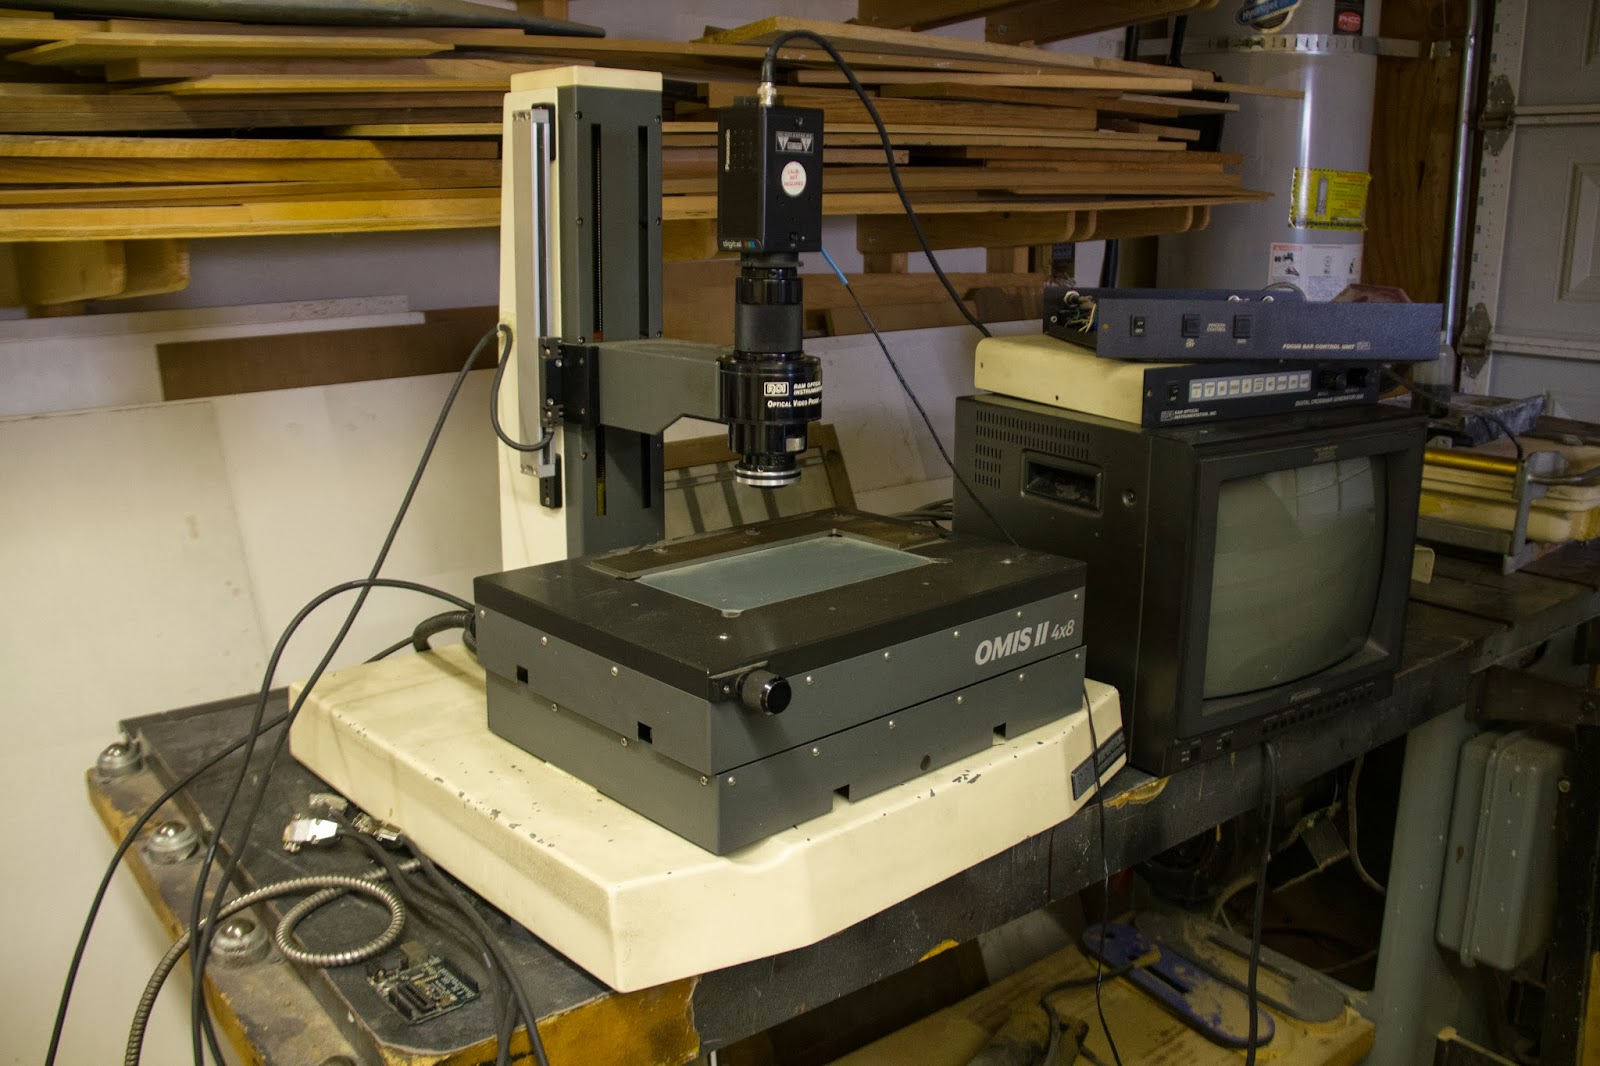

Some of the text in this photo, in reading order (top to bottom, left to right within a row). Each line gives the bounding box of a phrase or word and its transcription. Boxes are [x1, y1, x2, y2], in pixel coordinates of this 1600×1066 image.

[723, 240, 742, 249] digital
[767, 400, 792, 408] OPTICAL
[975, 619, 1075, 666] OMIS II 4x8
